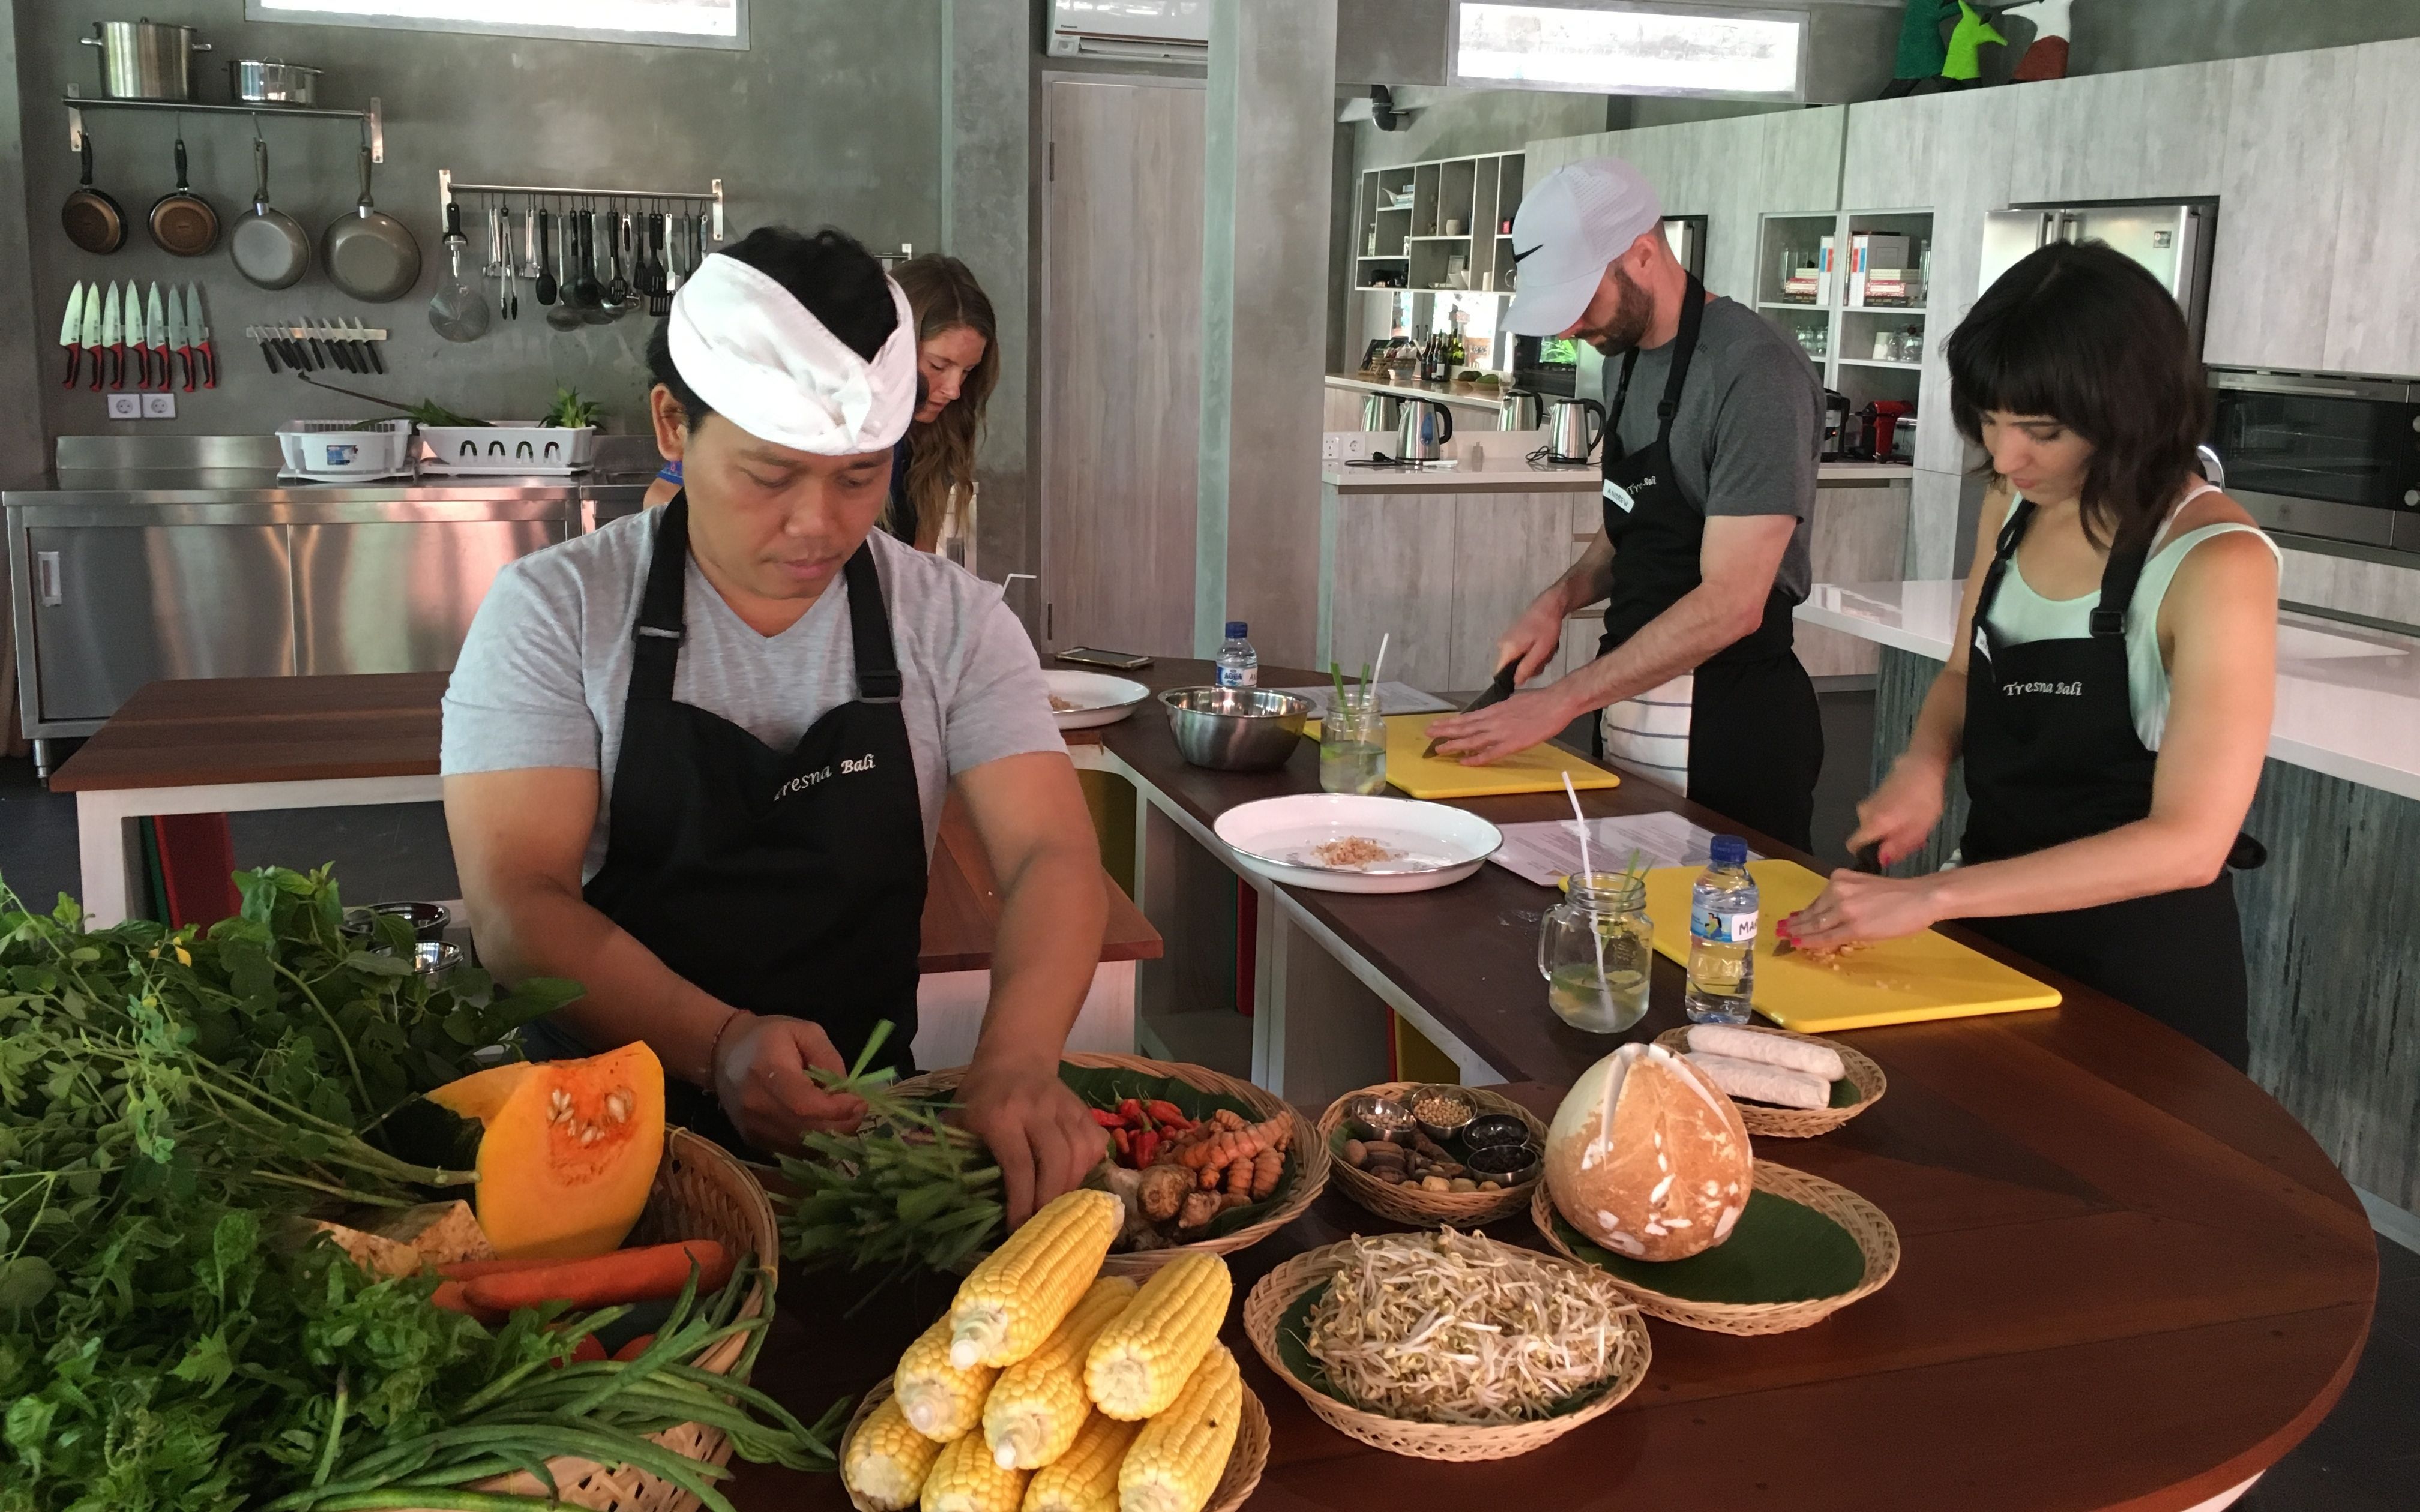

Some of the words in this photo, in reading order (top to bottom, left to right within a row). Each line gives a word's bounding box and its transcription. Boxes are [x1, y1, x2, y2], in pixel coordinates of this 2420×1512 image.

[2003, 681, 2053, 696] Tresna
[2055, 682, 2083, 696] Bali
[841, 754, 876, 774] Bali
